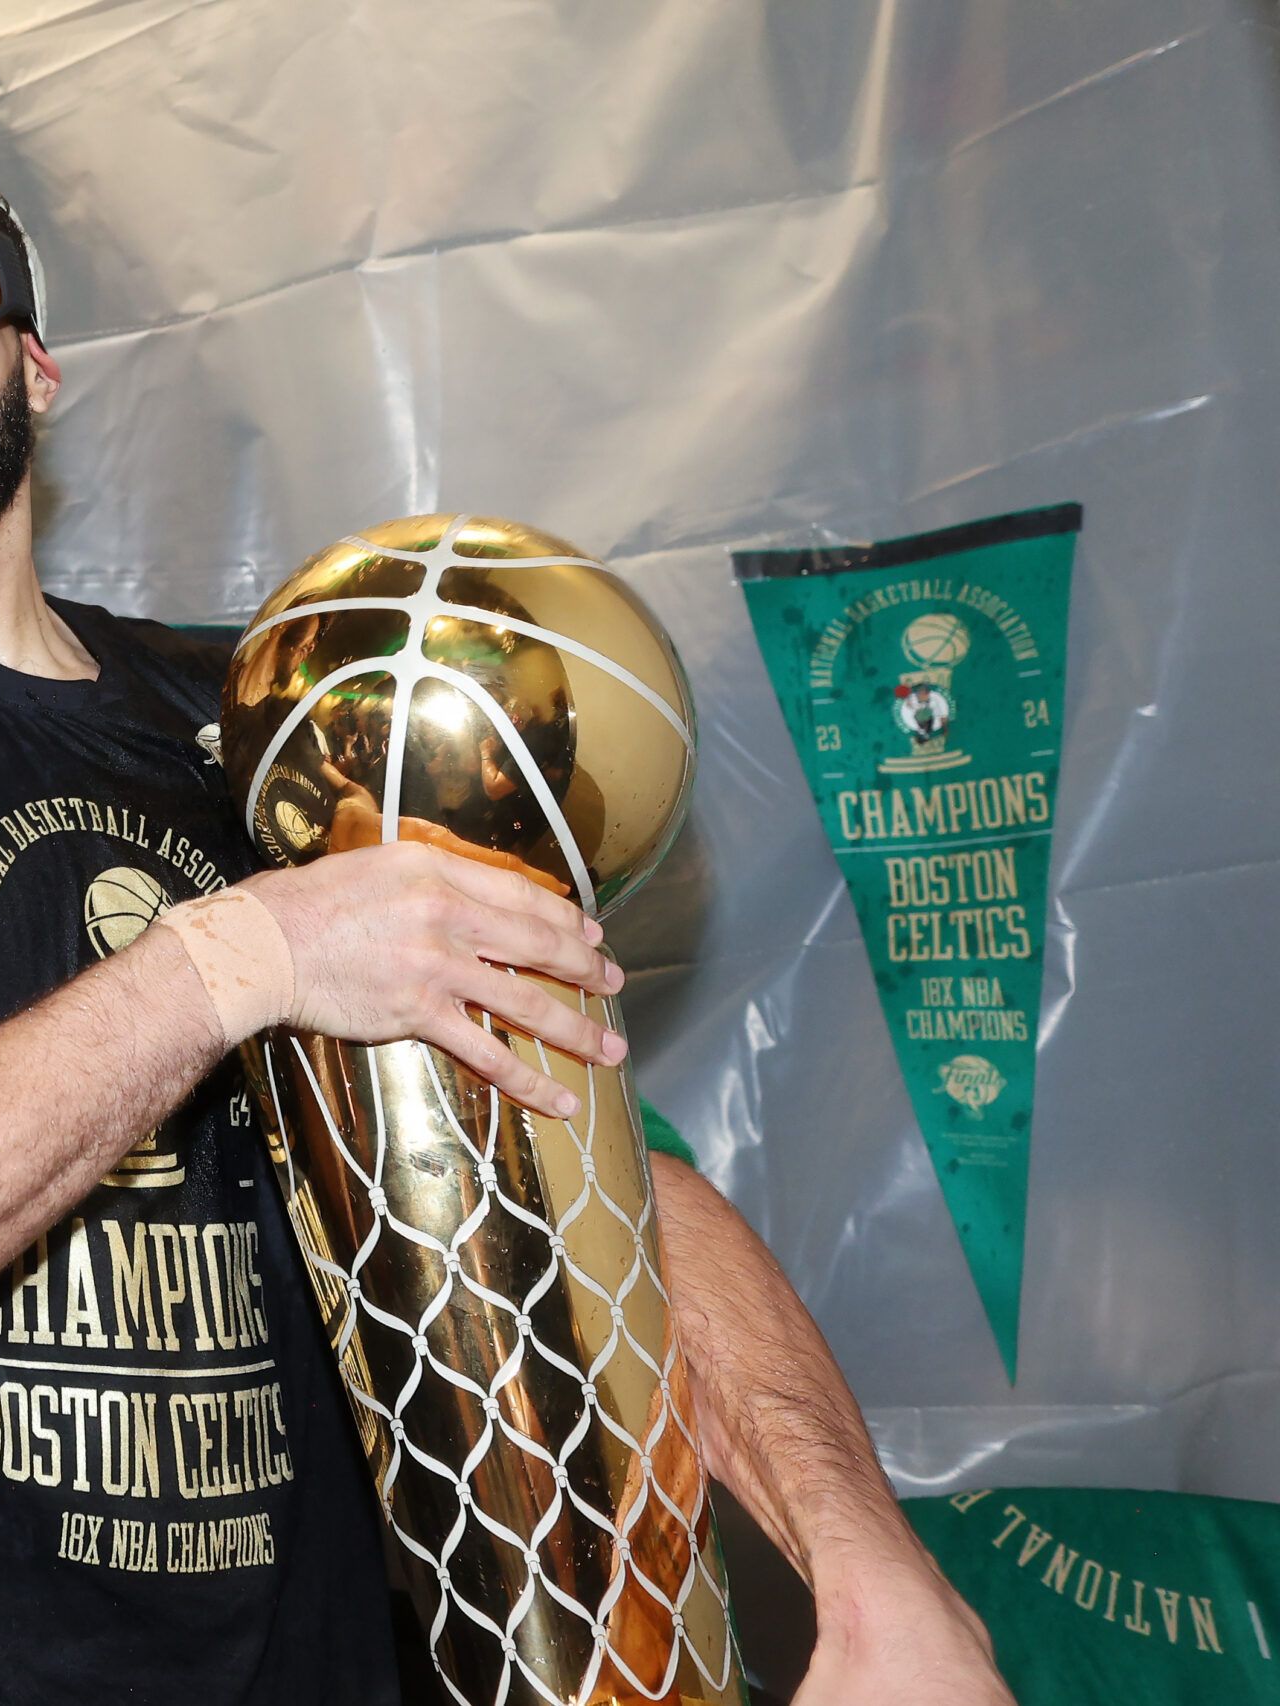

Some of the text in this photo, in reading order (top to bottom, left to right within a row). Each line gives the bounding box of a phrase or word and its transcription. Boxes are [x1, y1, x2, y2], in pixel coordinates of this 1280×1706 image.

[810, 579, 1039, 688] NATIONAL BASKETBALL ASSOCIATION
[816, 725, 842, 751] 23
[1023, 699, 1050, 728] 24
[0, 798, 149, 851] BASKETBALL
[838, 772, 1049, 841] CHAMPIONS
[885, 847, 1018, 908] BOSTON
[887, 905, 1032, 962] CELTICS
[921, 977, 1005, 1007] 18X NBA
[906, 1010, 1028, 1041] CHAMPIONS
[168, 1382, 295, 1499] CELTICS
[58, 1511, 275, 1574] 18X NBA CHAMPIONS
[992, 1504, 1223, 1654] NATIONAL
